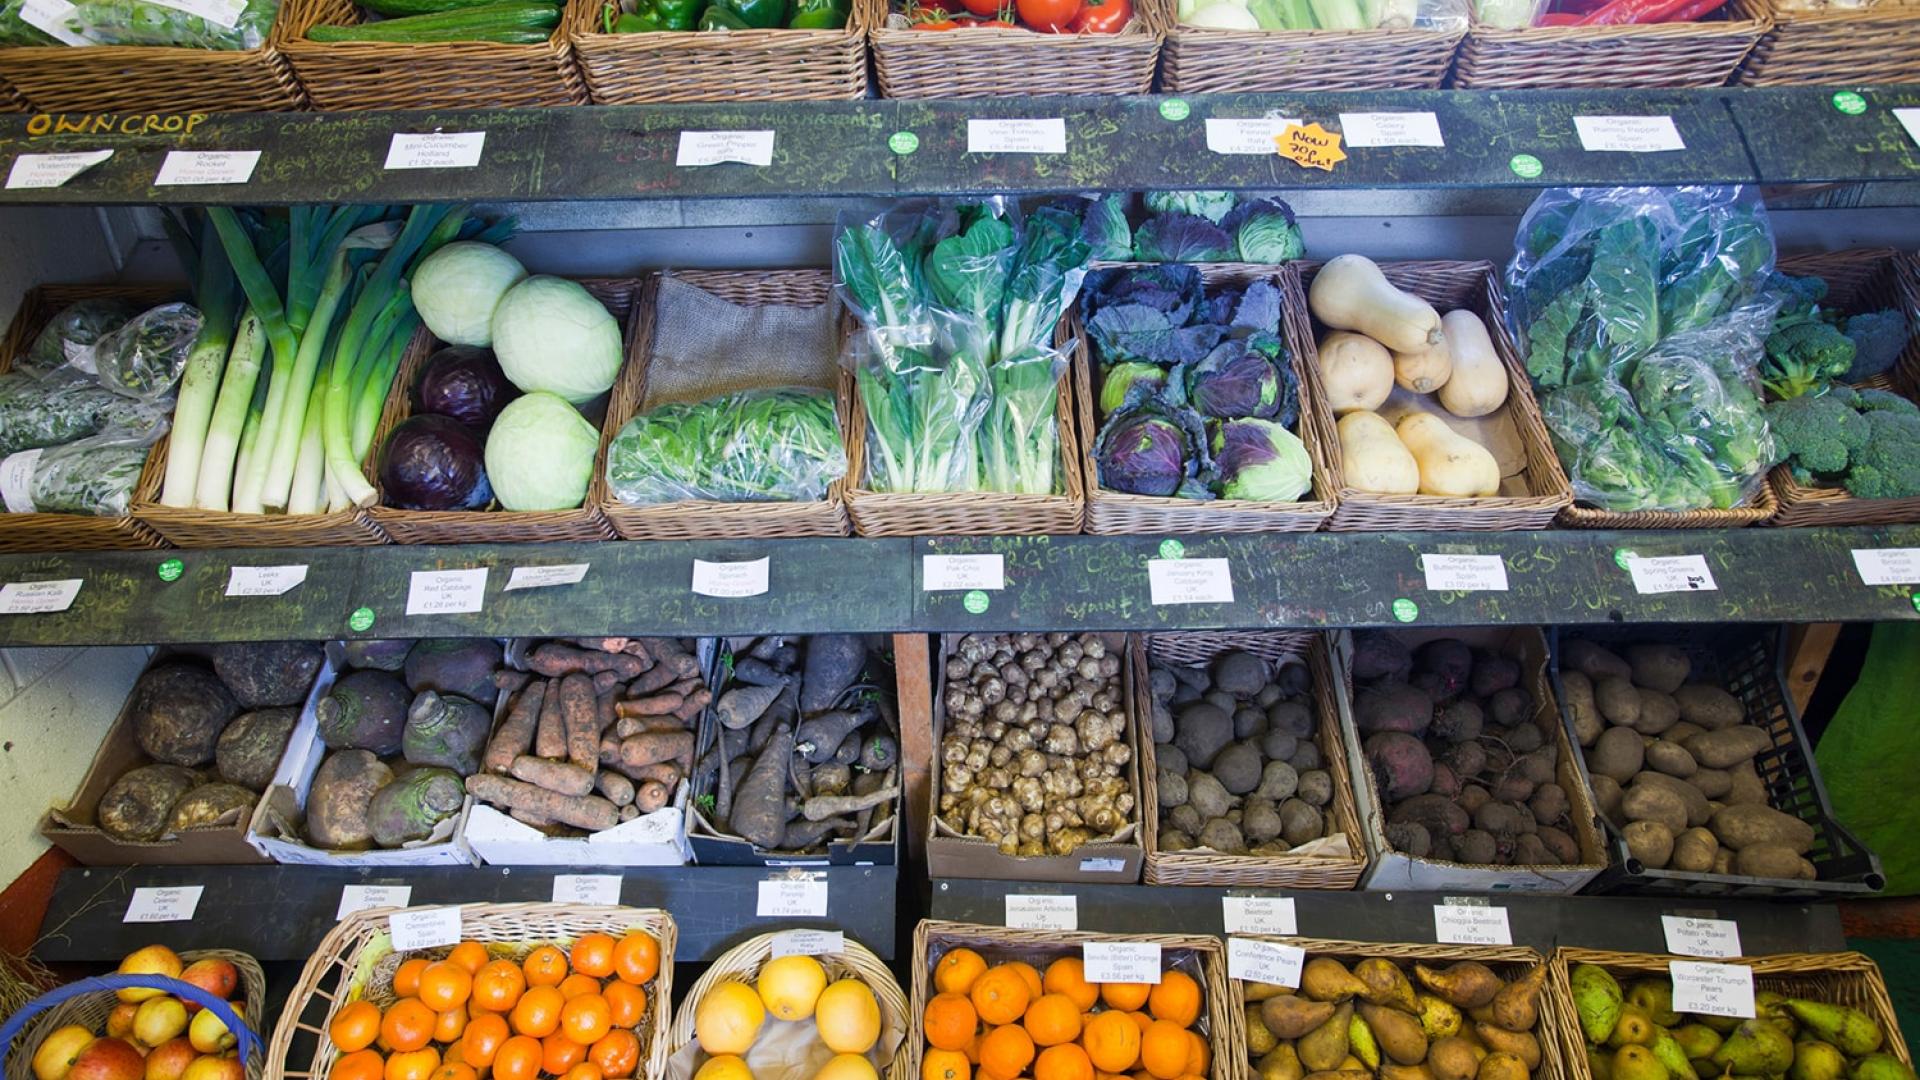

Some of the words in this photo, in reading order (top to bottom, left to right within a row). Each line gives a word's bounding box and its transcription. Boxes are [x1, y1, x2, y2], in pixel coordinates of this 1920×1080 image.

[1376, 122, 1404, 130] Celery
[1292, 130, 1329, 147] Now
[364, 887, 389, 895] Organic
[411, 913, 437, 921] Organic
[405, 921, 445, 929] Clementines
[418, 929, 436, 937] Spain
[1677, 929, 1699, 937] Potato
[1706, 930, 1726, 938] Baker
[1109, 945, 1135, 953] Organic
[1134, 954, 1158, 962] Orange
[1236, 951, 1275, 961] Conference
[1276, 956, 1296, 966] Pears
[1695, 965, 1724, 974] Organic
[1262, 972, 1275, 980] per
[1276, 975, 1285, 984] kg
[1716, 976, 1748, 985] Triumph
[1701, 985, 1723, 993] Pears
[1727, 1006, 1737, 1015] kg
